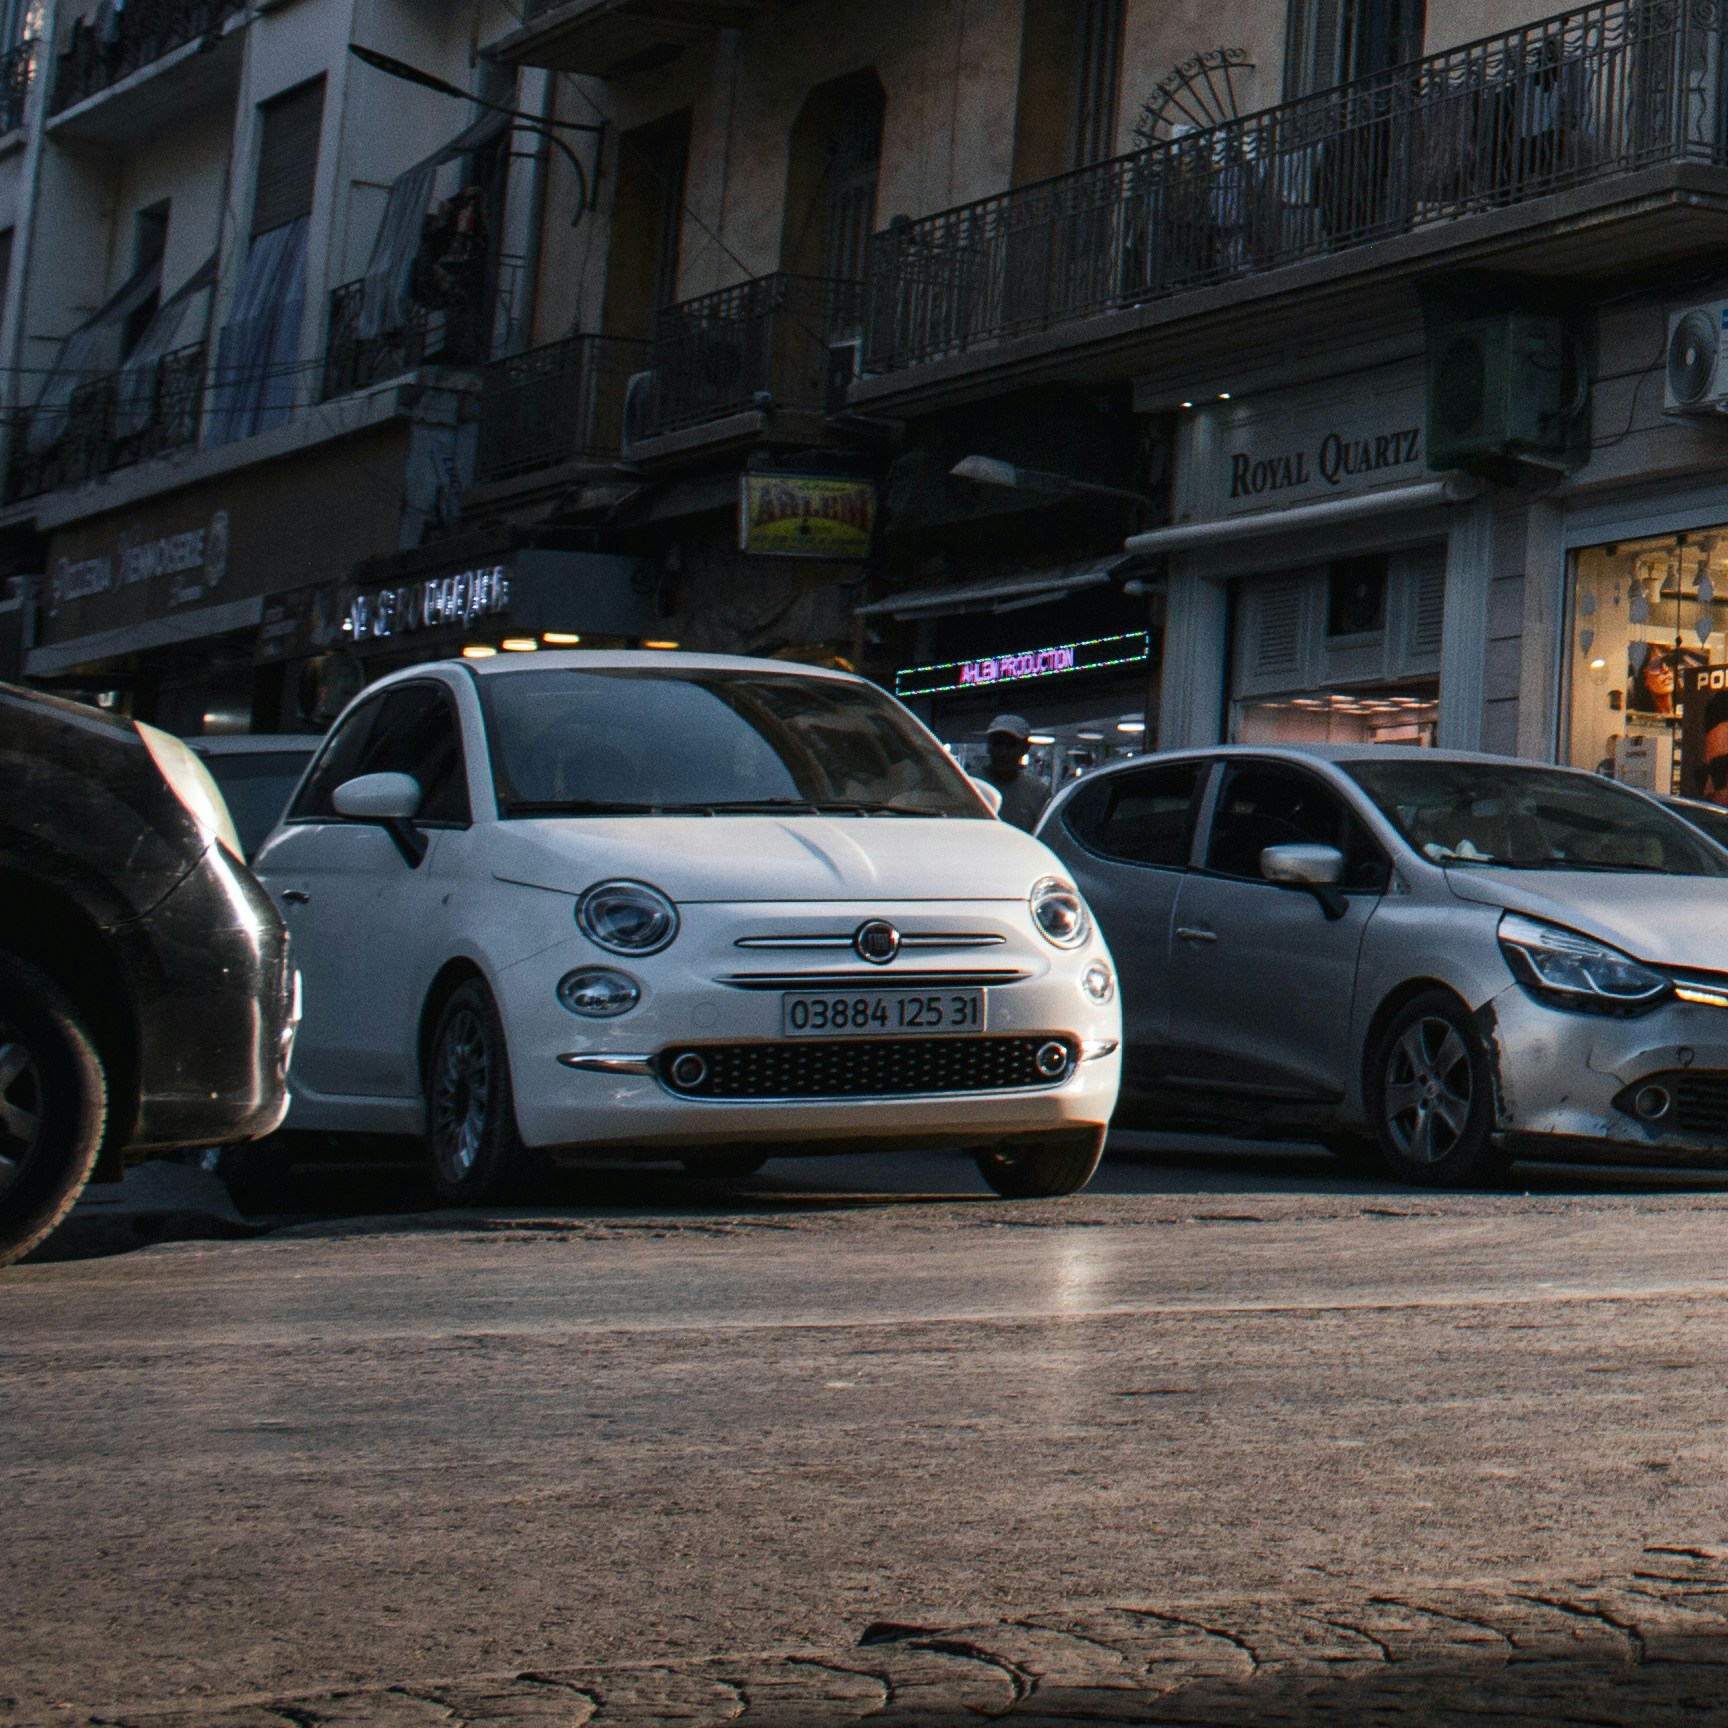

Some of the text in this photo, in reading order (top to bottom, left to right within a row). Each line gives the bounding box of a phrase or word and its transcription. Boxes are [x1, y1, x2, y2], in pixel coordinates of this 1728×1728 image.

[1230, 428, 1420, 499] ROYAL QUARTZ
[999, 647, 1076, 680] PRODUCTION
[790, 996, 978, 1030] 03884 125 31
